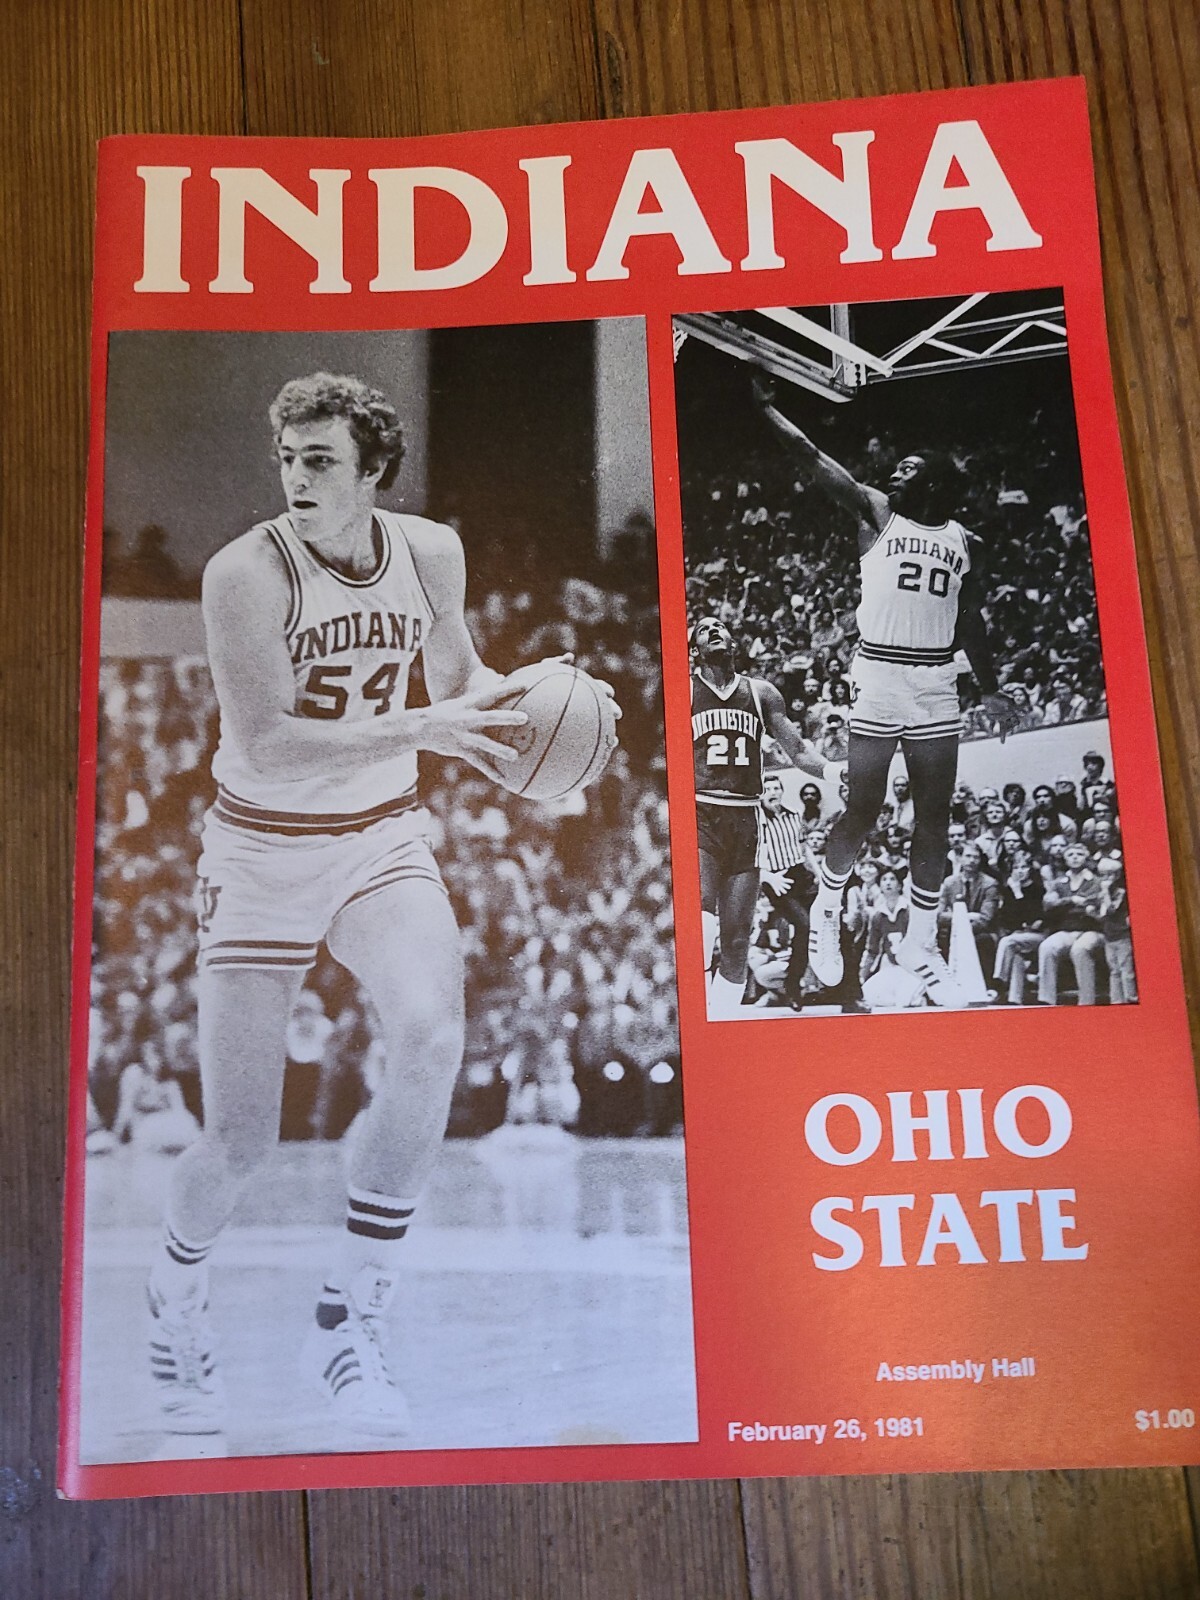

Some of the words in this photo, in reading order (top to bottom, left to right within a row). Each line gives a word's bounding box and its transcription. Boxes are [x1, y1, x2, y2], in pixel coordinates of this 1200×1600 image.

[132, 120, 1043, 295] INDIANA
[886, 536, 964, 576] INDIANA
[898, 561, 951, 598] 20
[291, 611, 423, 664] INDIANA
[302, 662, 401, 720] 54
[706, 734, 750, 766] 21
[804, 1084, 1073, 1167] OHIO
[810, 1188, 1089, 1272] STATE
[876, 1359, 985, 1384] Assembly
[992, 1357, 1036, 1378] Hall
[728, 1420, 827, 1445] February
[833, 1419, 867, 1442] 26,
[874, 1416, 924, 1438] 1981
[1135, 1408, 1195, 1431] $1.00
